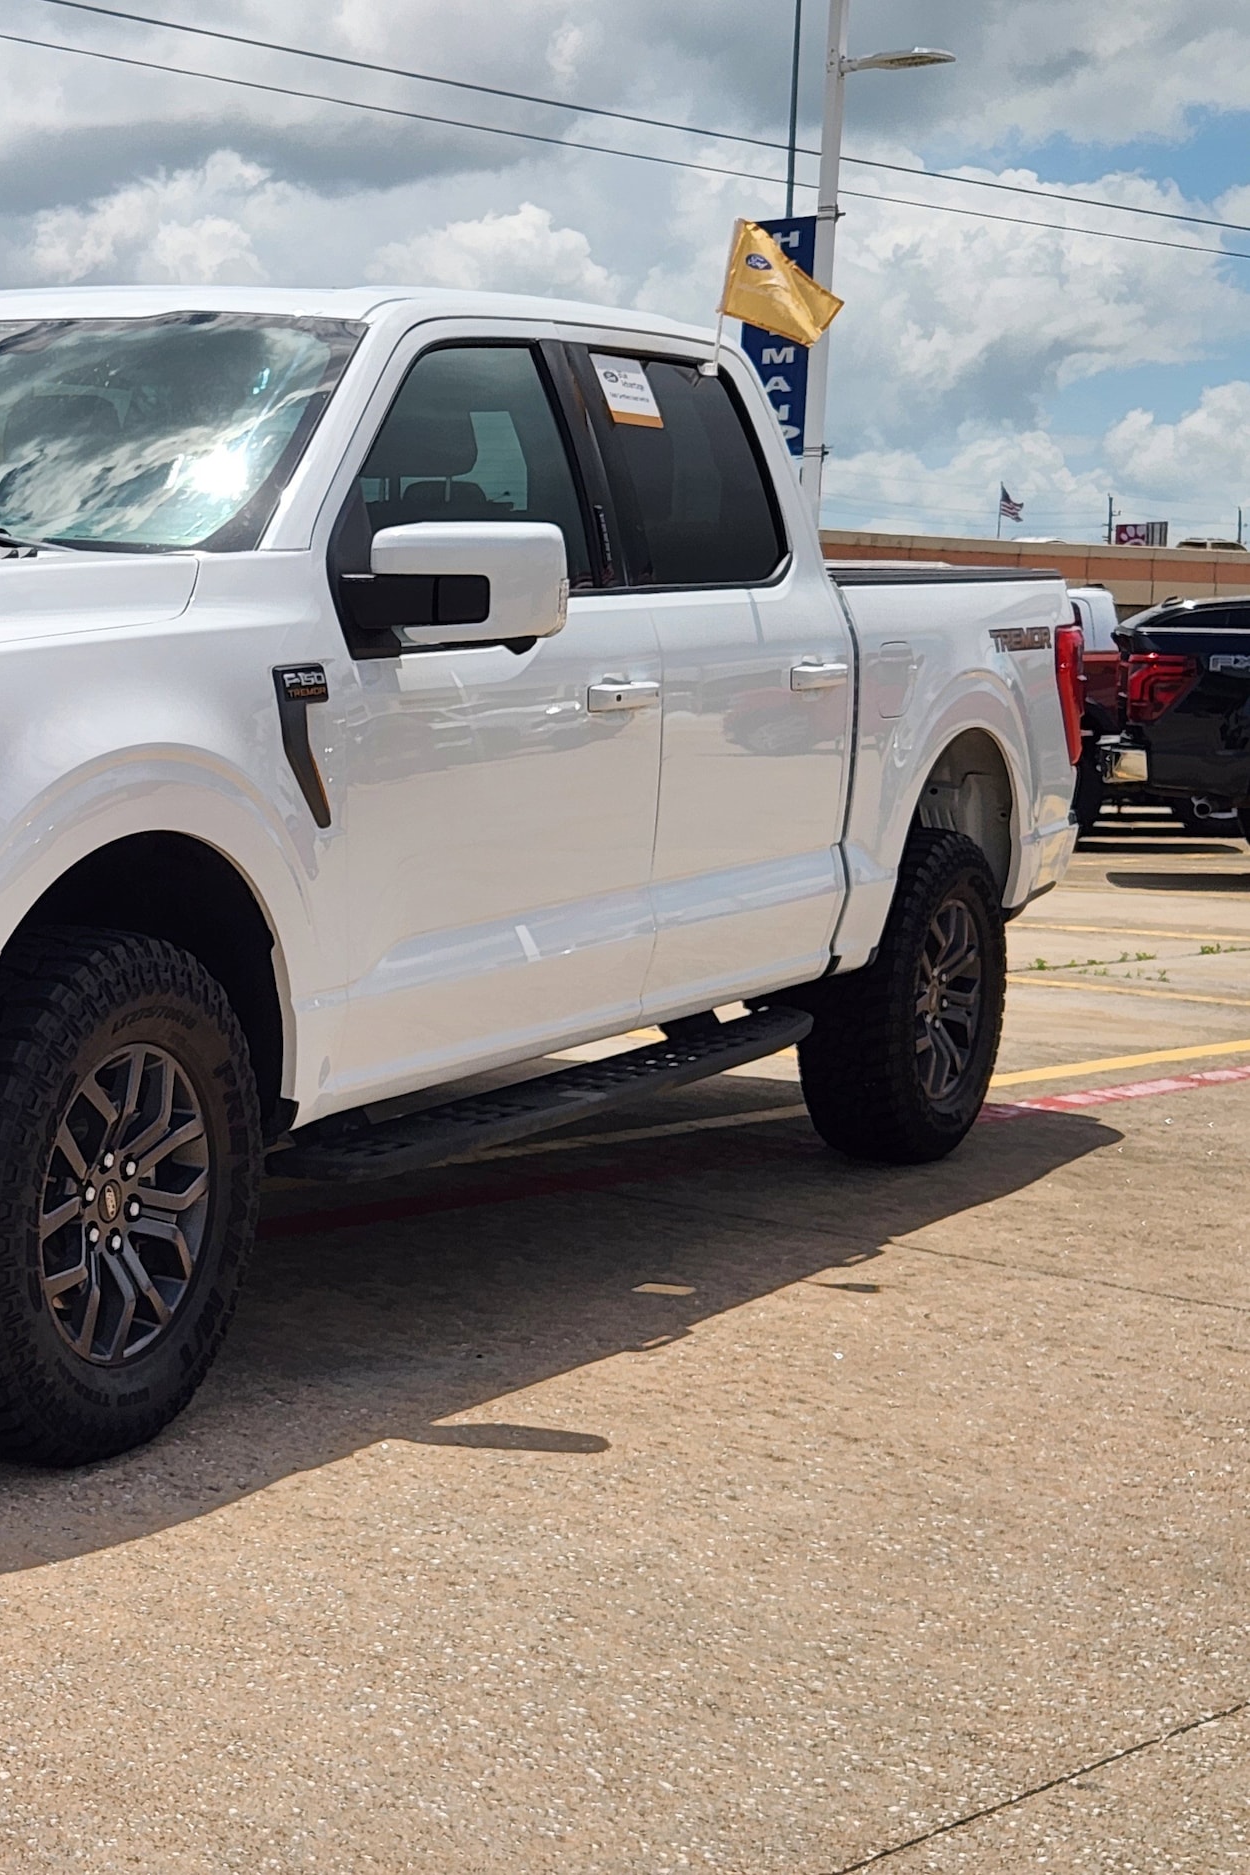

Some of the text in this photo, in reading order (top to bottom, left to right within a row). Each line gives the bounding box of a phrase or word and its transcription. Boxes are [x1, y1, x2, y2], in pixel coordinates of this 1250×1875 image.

[988, 626, 1052, 653] TREMOR
[283, 671, 326, 687] F-150
[288, 687, 327, 698] TREMOR
